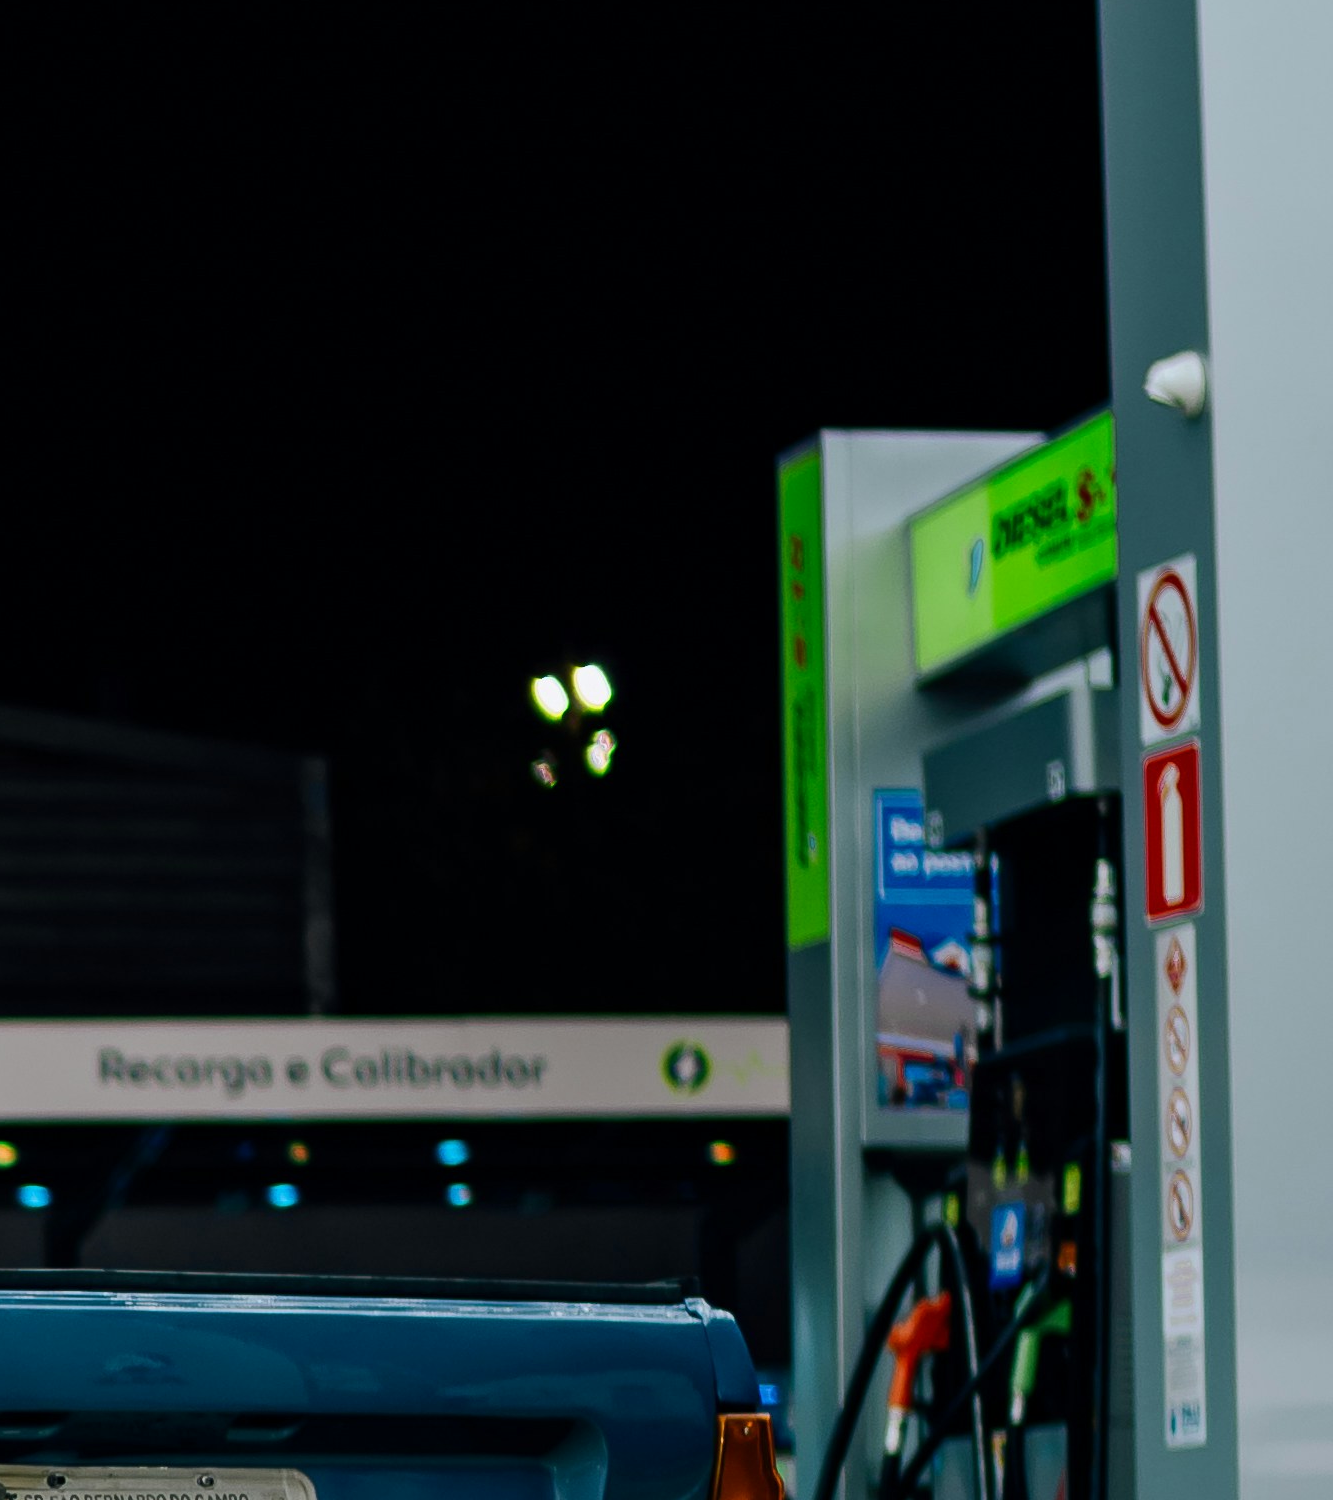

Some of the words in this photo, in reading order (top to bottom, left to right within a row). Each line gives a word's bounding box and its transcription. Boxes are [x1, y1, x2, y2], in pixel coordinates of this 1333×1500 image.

[98, 1046, 271, 1097] Recarga
[286, 1057, 309, 1087] e
[322, 1047, 548, 1089] Calibrador
